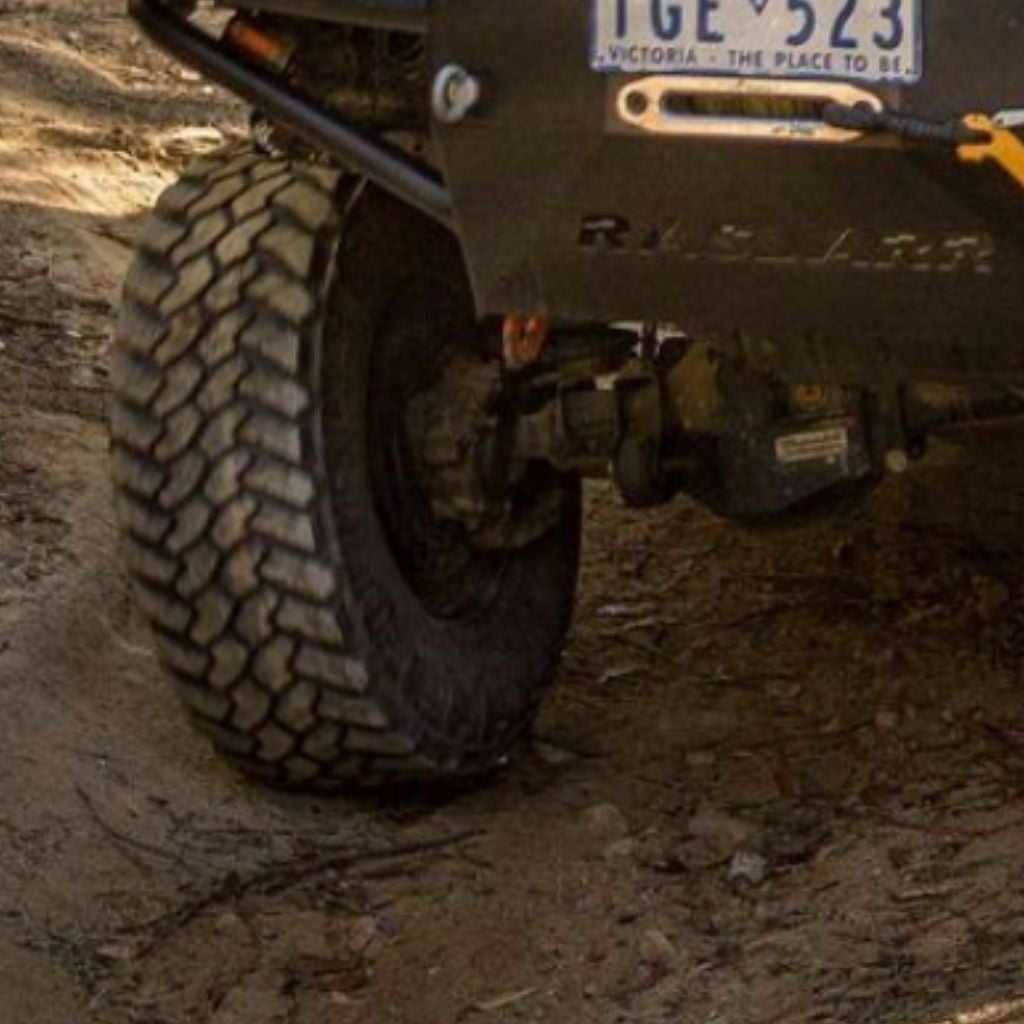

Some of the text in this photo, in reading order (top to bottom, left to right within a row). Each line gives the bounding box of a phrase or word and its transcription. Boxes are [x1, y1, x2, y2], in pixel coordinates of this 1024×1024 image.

[608, 44, 698, 65] VICTORIA
[728, 49, 763, 68] THE
[774, 51, 833, 72] PLACE
[844, 55, 868, 73] TO
